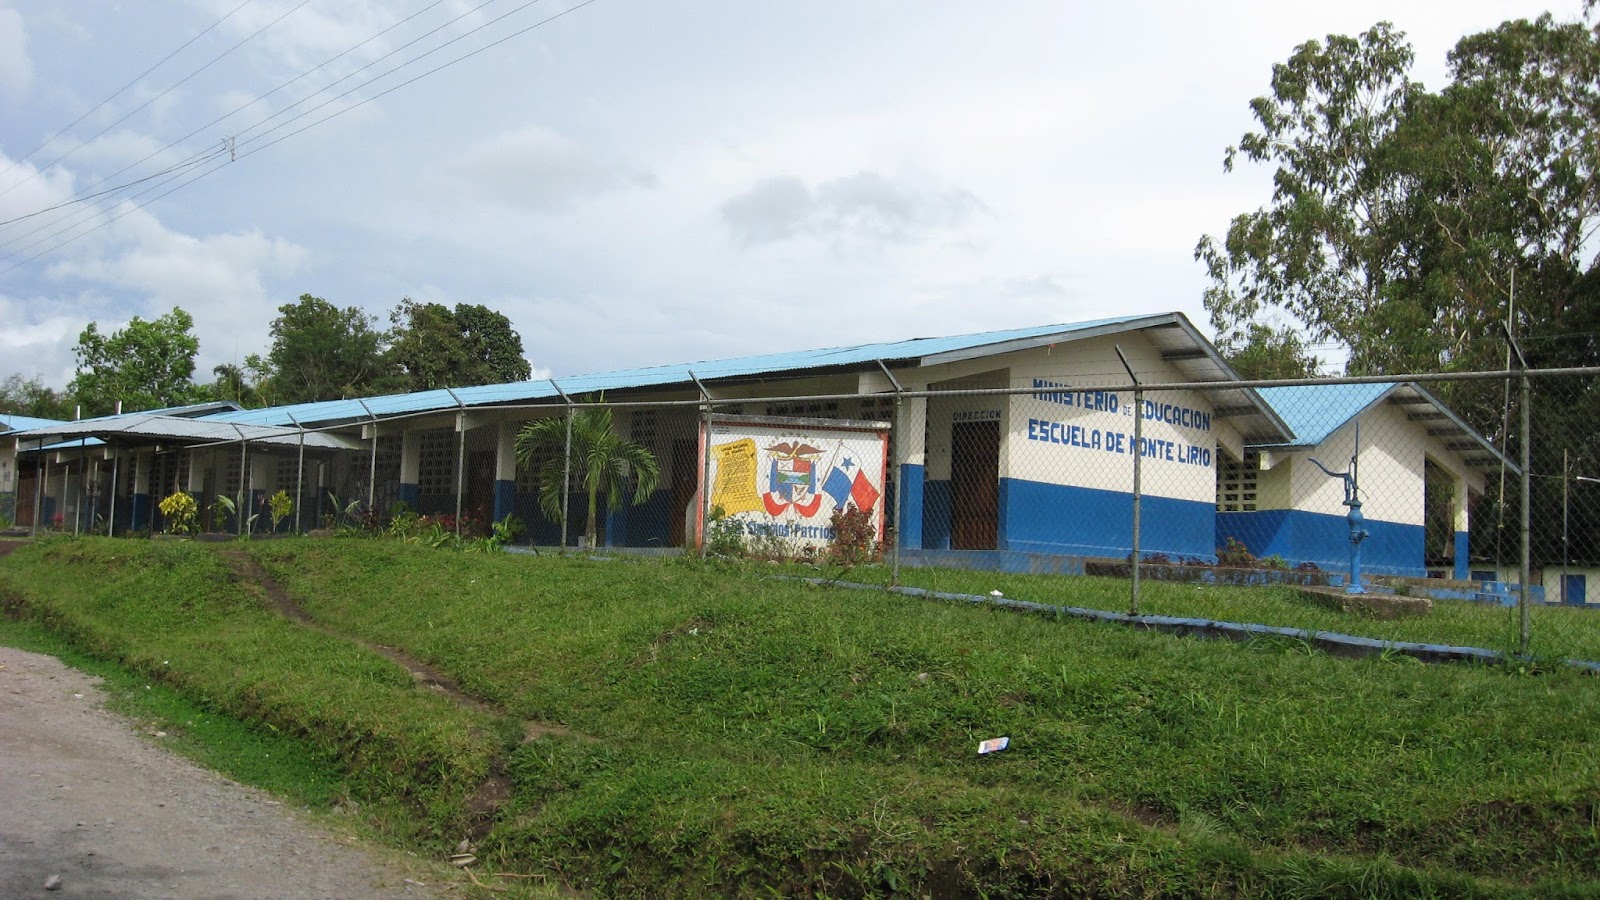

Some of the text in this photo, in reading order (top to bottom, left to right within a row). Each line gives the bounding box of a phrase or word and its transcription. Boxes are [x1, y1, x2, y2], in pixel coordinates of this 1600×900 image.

[952, 410, 1001, 421] DIRECCION
[1032, 378, 1118, 413] MINISTERIO
[1123, 405, 1132, 416] DE
[1028, 418, 1101, 450] ESCUELA
[1105, 431, 1125, 453] DE
[1178, 443, 1211, 467] LIRIO
